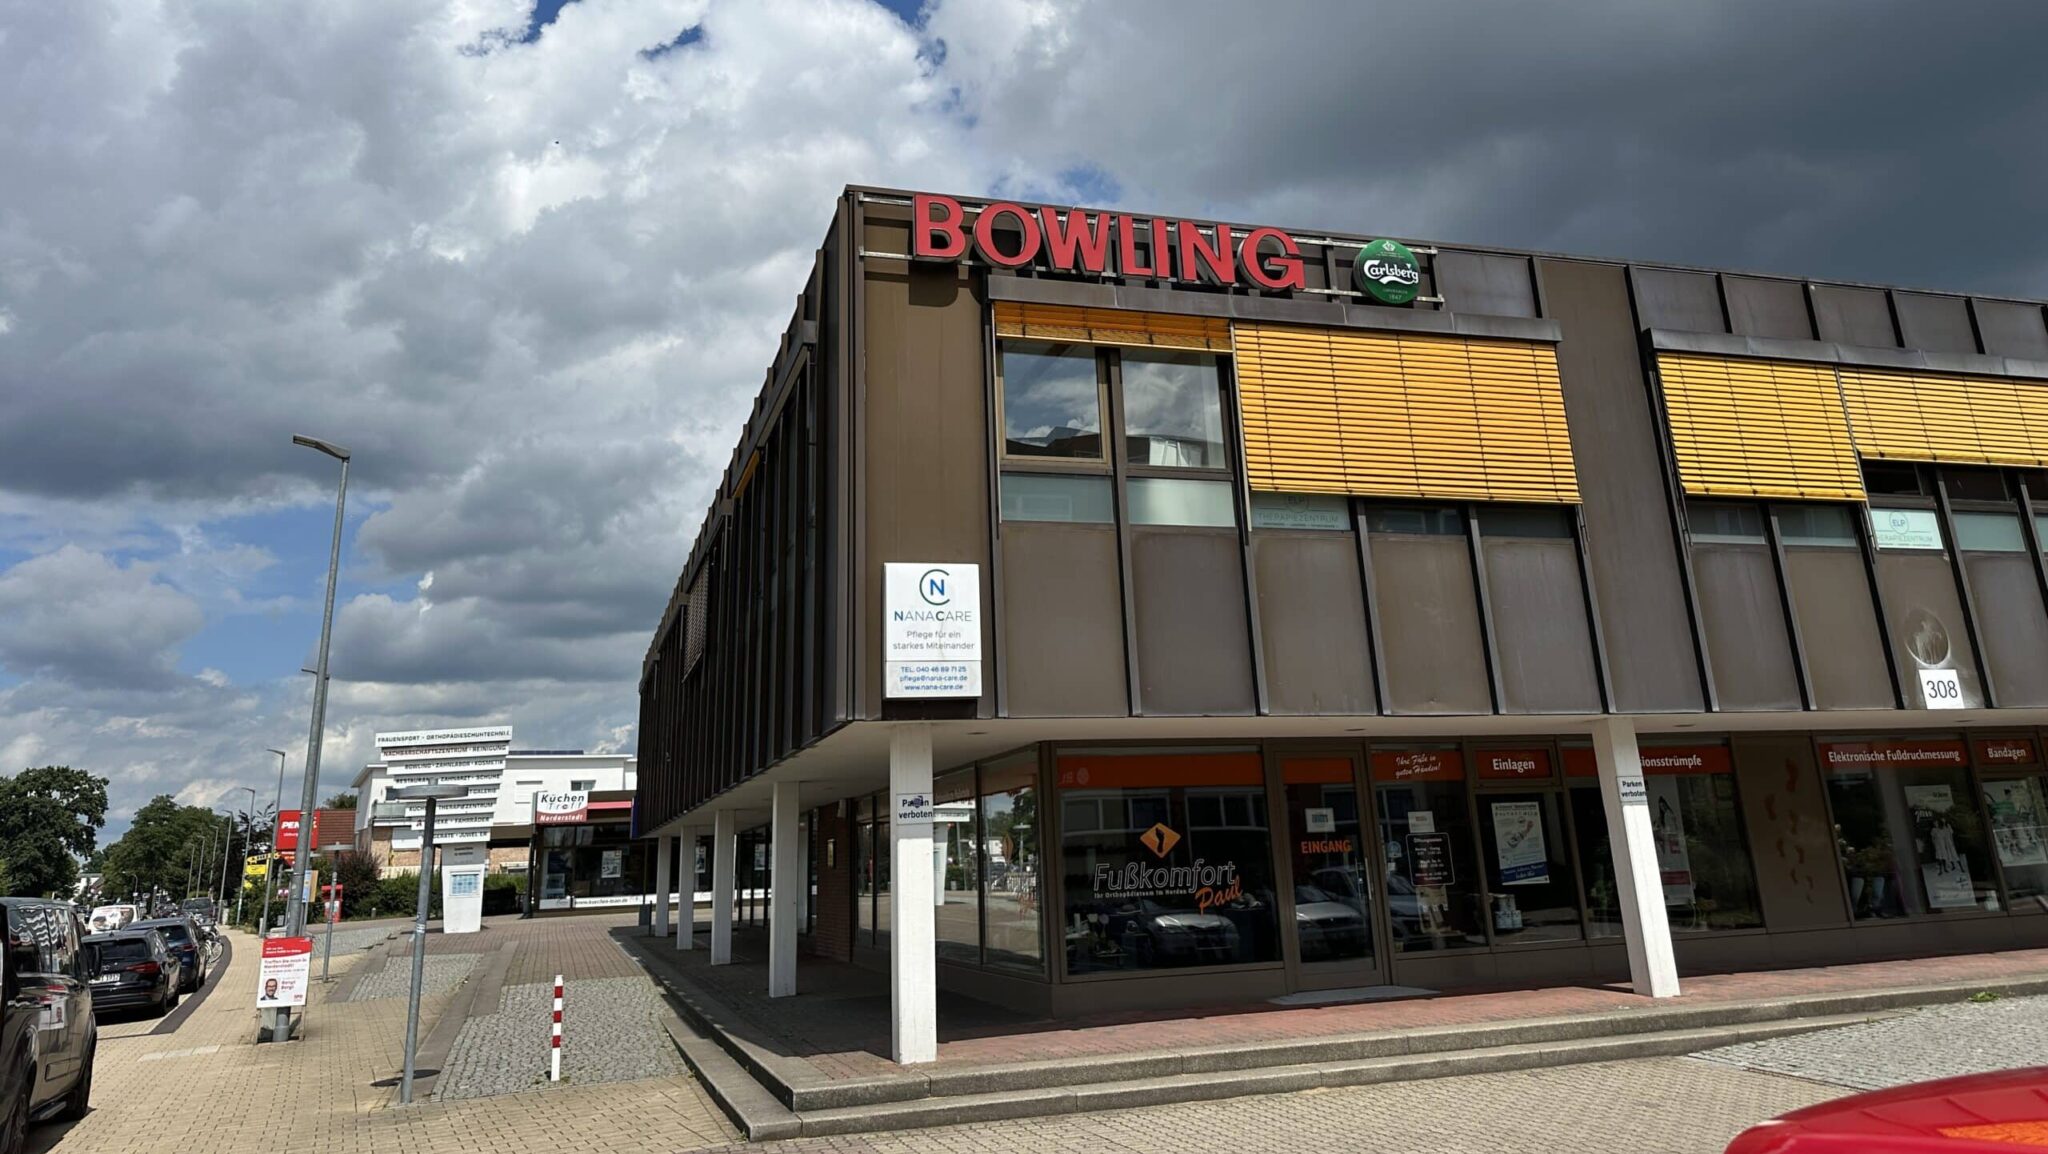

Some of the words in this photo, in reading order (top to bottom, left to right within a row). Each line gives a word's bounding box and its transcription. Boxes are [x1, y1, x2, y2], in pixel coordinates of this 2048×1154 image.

[913, 193, 1305, 290] BOWLING
[1364, 259, 1419, 284] Carlsberg
[1892, 519, 1906, 527] ELP
[1879, 532, 1933, 542] ERAPIEZENTRUM
[894, 610, 972, 621] NANACARE
[907, 630, 933, 639] Pflege
[935, 630, 947, 638] für
[1926, 680, 1958, 699] 308
[383, 747, 468, 756] NACHBARSCHAFTSZENTRUM
[473, 745, 506, 753] REINIGUNG
[1828, 751, 1885, 763] Elektronische
[1886, 748, 1961, 762] Fußdruckmessung
[1987, 747, 2027, 760] Bandagen
[1396, 756, 1410, 766] Ihre
[1492, 758, 1536, 773] Einlagen
[1641, 754, 1702, 769] ionsstrümpfe
[1395, 769, 1412, 779] guten
[1412, 762, 1441, 774] Händen!
[540, 793, 585, 803] Küchen
[1621, 790, 1647, 798] verboten
[455, 816, 490, 824] FAHRRÄDER
[540, 813, 584, 822] Norderstedt
[898, 810, 933, 819] verboten
[1300, 839, 1352, 854] EINGANG
[1094, 858, 1236, 894] Fußkomfort
[1094, 891, 1104, 899] Ihr
[1194, 874, 1244, 916] Paul
